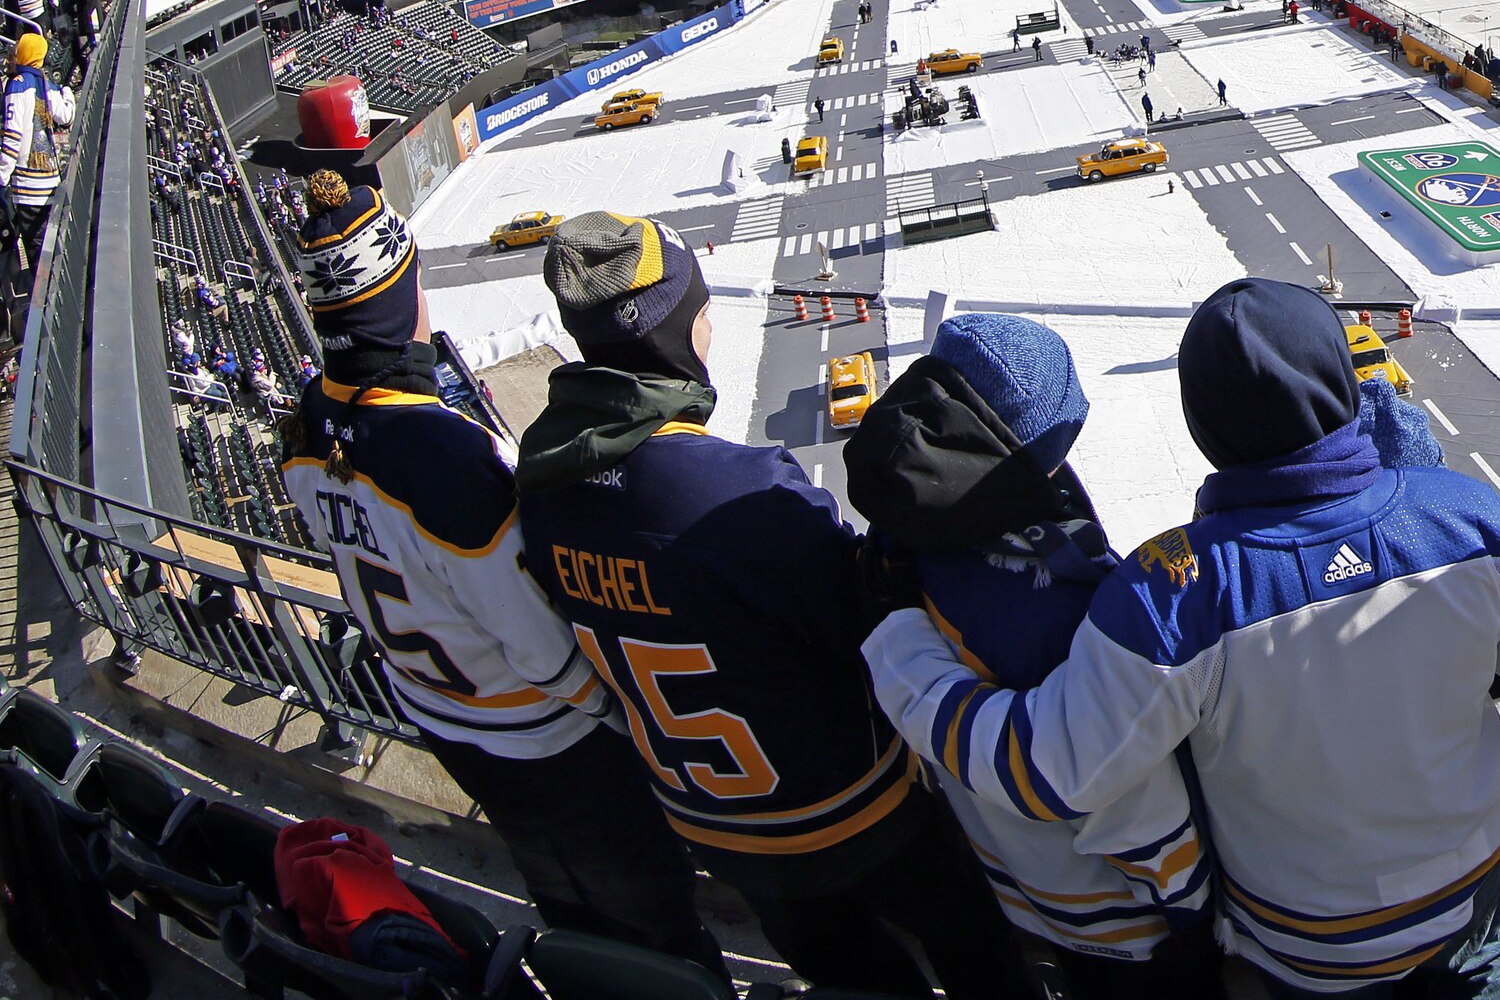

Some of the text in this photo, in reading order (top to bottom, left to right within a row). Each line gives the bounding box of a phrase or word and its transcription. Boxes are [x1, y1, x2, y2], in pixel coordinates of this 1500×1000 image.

[681, 17, 719, 43] GEICO
[598, 49, 649, 78] HONDA
[486, 92, 549, 131] BRIDGESTONE
[1382, 157, 1407, 172] WEST
[1419, 153, 1446, 168] 90
[1456, 215, 1492, 238] NORTH
[325, 418, 354, 443] Reok
[552, 544, 673, 616] EICHEL
[1325, 560, 1373, 584] adidas
[571, 621, 780, 800] 15
